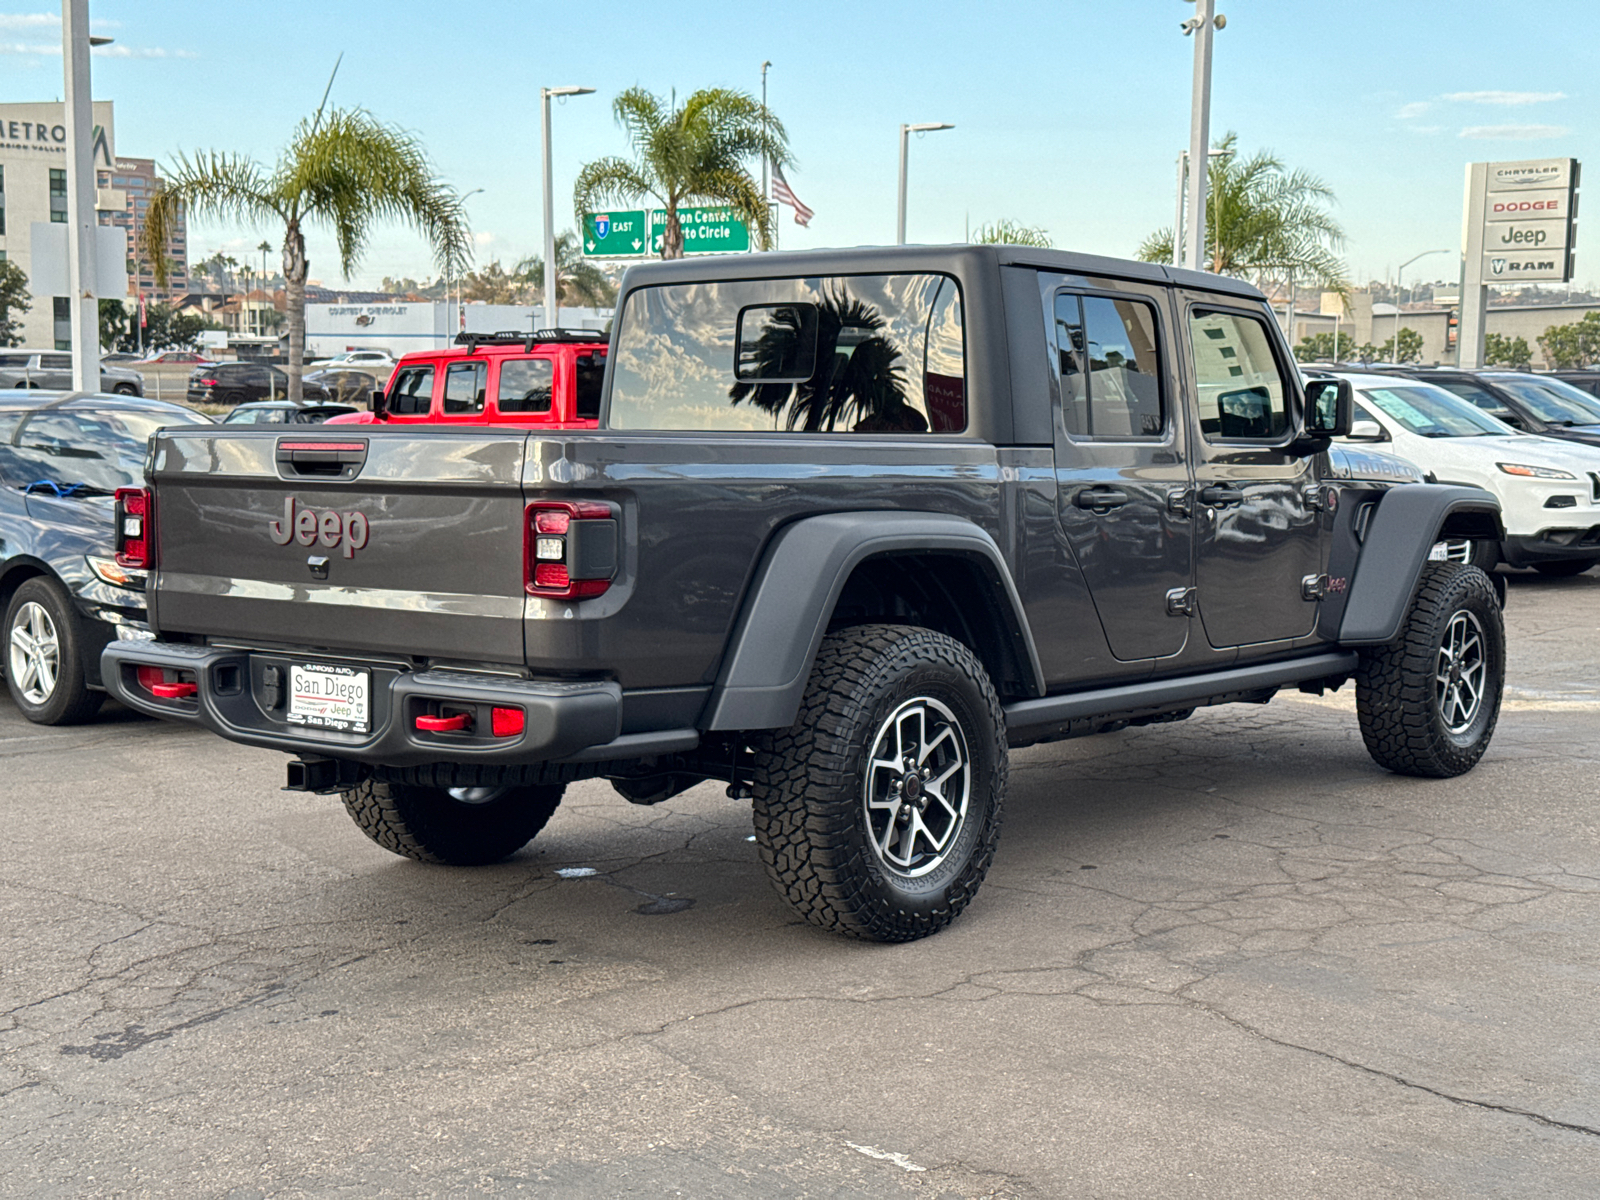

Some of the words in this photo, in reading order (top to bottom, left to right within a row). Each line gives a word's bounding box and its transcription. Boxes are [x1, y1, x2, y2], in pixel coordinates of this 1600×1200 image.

[1497, 167, 1558, 176] CHRYSLER
[1493, 200, 1558, 212] DODGE
[694, 211, 731, 224] Center
[598, 222, 605, 234] 8
[612, 222, 633, 232] EAST
[698, 225, 730, 239] Circle
[1501, 226, 1546, 246] Jeep
[1508, 261, 1554, 271] RAM
[328, 307, 363, 316] COURTESY
[367, 307, 407, 315] CHEVROLET
[1357, 461, 1421, 479] RUBICON
[269, 497, 370, 559] Jeep
[335, 667, 352, 675] AUTO
[295, 674, 320, 694] San
[324, 676, 363, 705] Diego
[330, 703, 352, 718] Jeep
[307, 716, 323, 725] San
[324, 717, 349, 730] Diego
